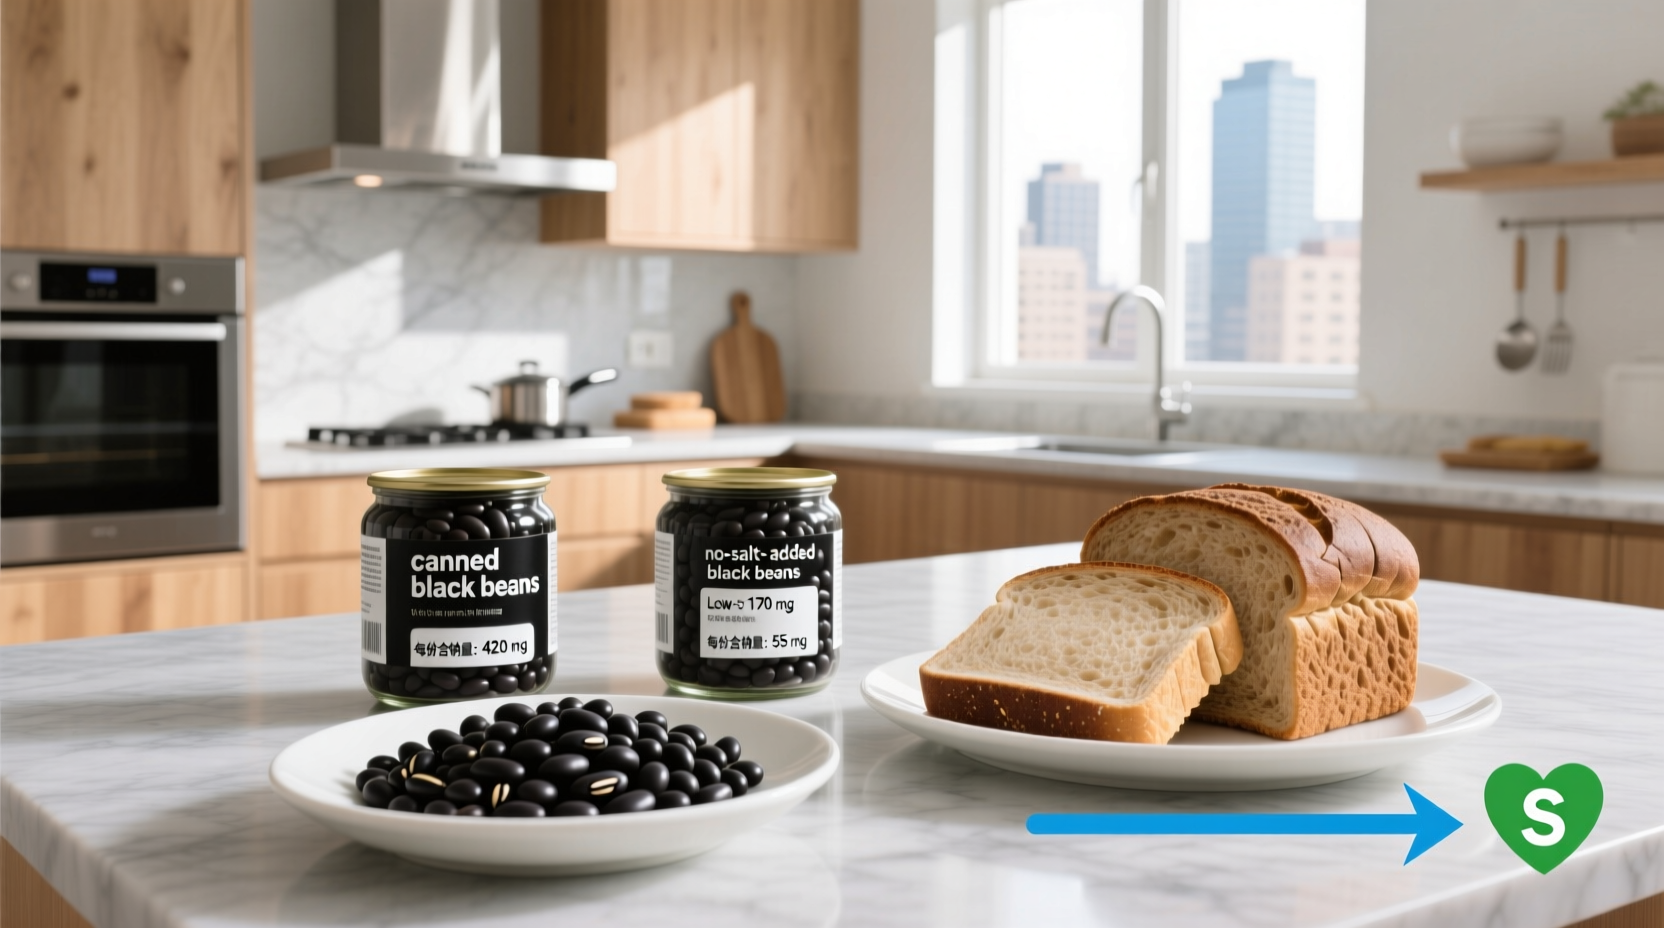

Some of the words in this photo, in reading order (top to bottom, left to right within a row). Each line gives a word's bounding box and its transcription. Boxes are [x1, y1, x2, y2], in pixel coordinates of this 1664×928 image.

[411, 547, 499, 572] canned
[707, 564, 751, 581] black
[755, 565, 801, 580] beans
[411, 575, 476, 598] black
[480, 575, 540, 598] beans
[747, 596, 773, 611] 170
[775, 599, 795, 614] mg
[482, 639, 508, 655] 420
[772, 633, 788, 648] 55
[790, 636, 807, 651] mg
